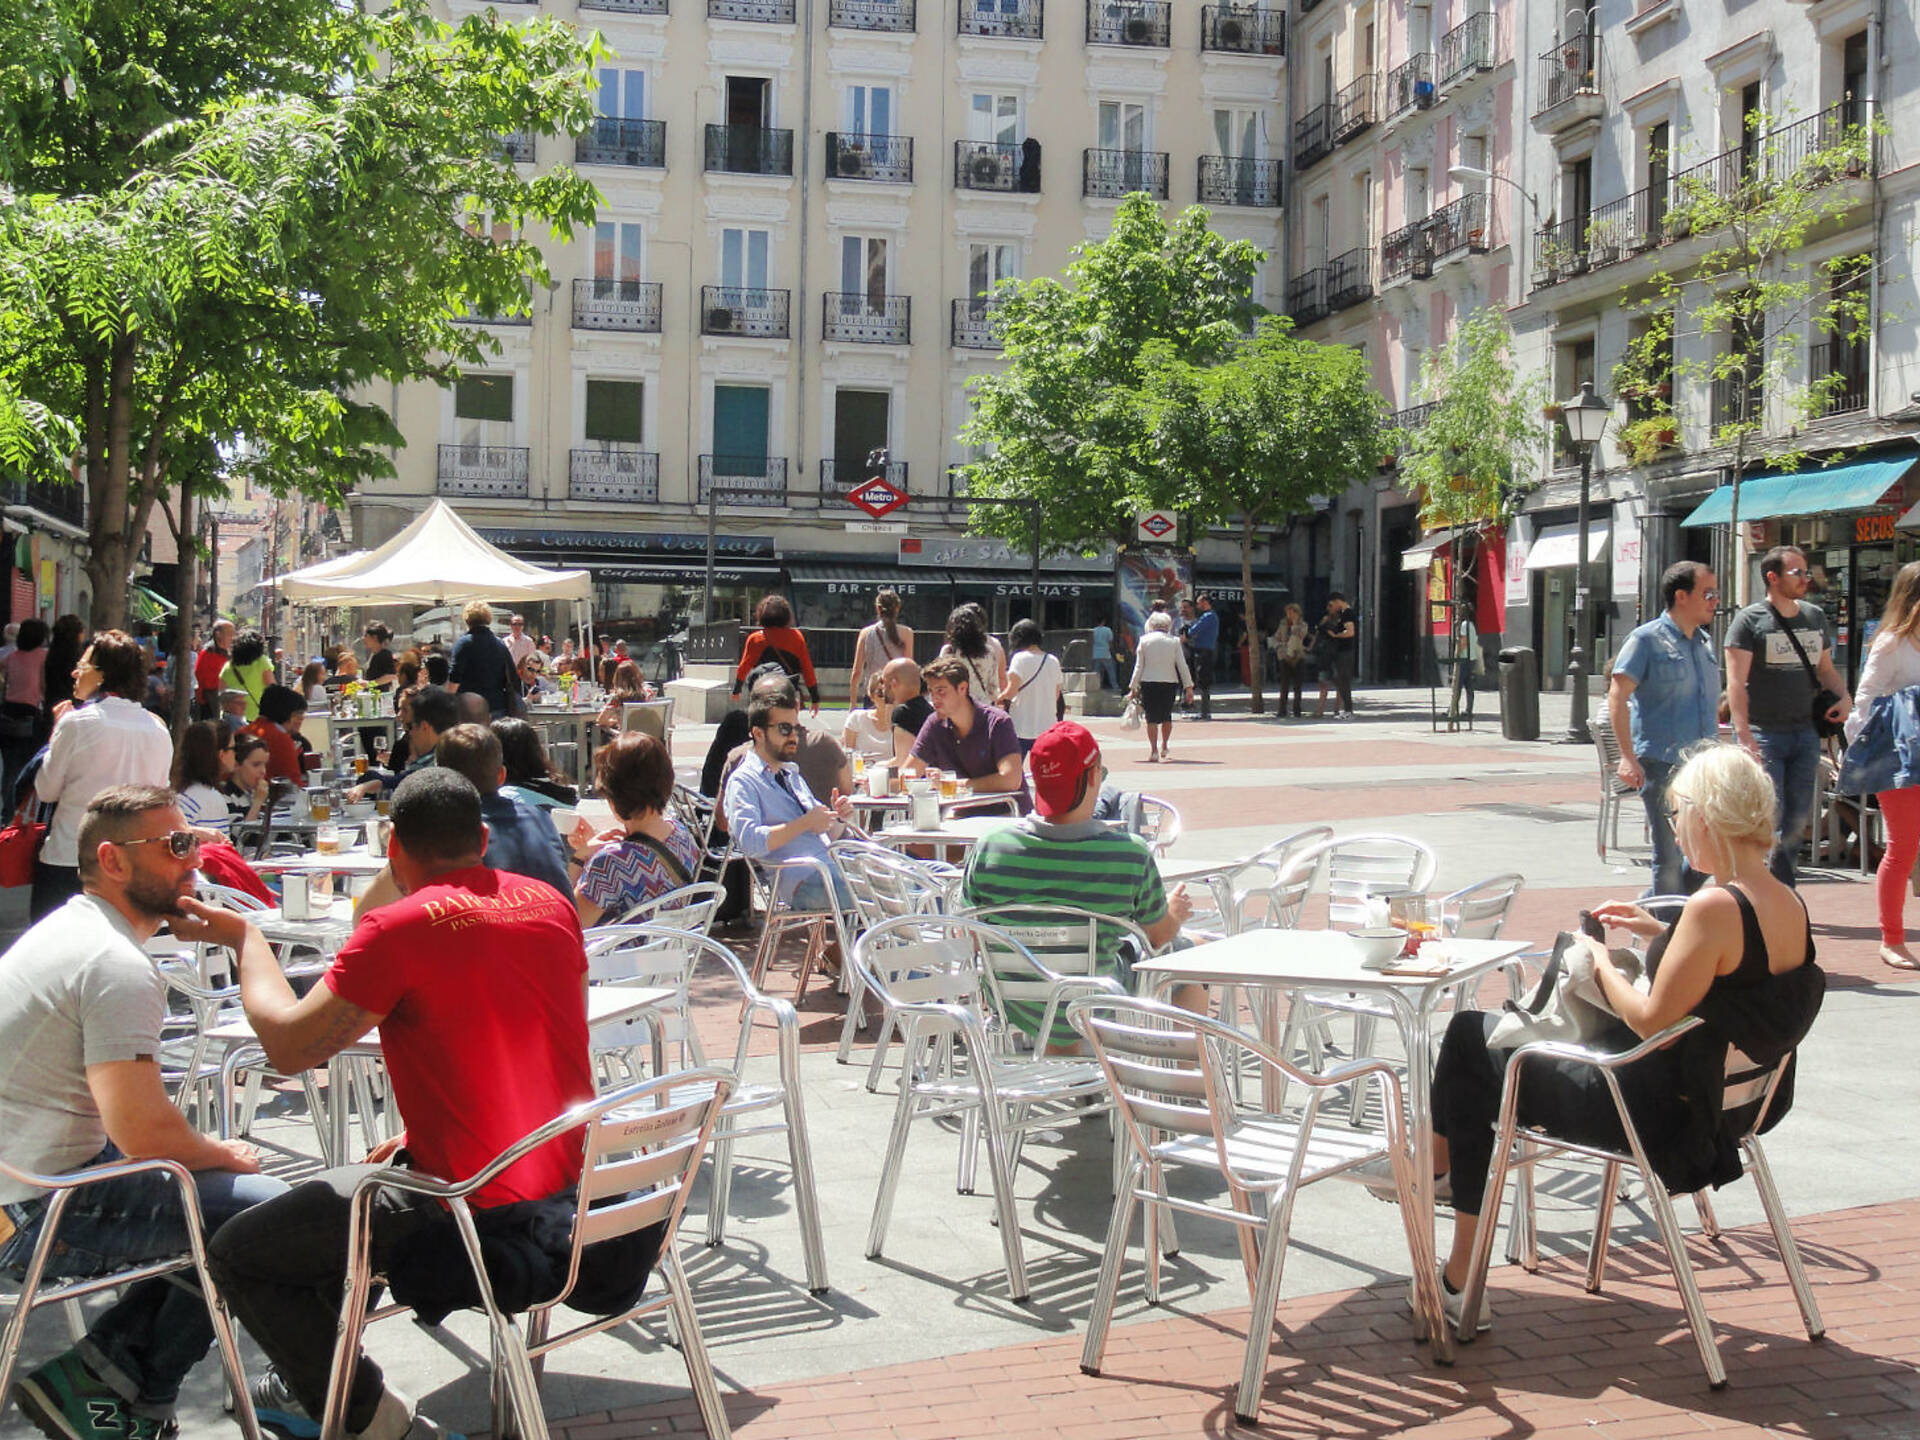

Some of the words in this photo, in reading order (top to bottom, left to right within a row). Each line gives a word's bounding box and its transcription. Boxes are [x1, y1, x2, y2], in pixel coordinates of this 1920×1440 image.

[864, 491, 893, 502] Metro
[1855, 515, 1895, 542] SECOS
[827, 583, 860, 594] BAR
[877, 585, 917, 594] CAFE
[995, 585, 1082, 597] SACHA'S
